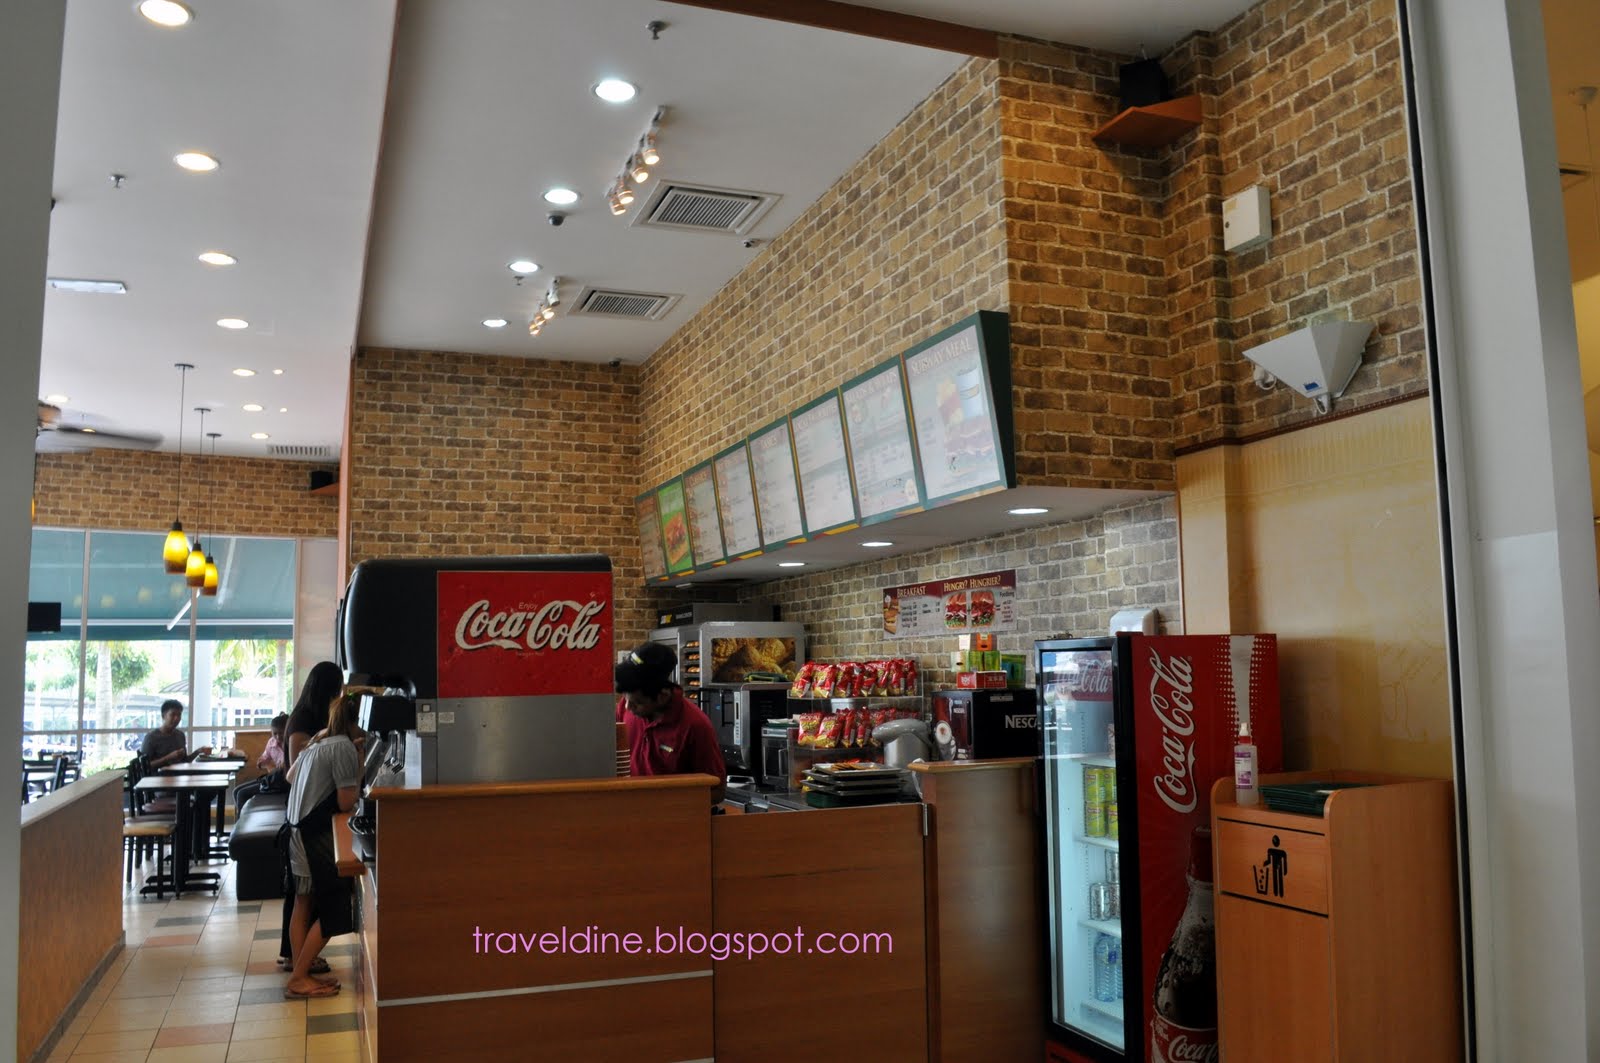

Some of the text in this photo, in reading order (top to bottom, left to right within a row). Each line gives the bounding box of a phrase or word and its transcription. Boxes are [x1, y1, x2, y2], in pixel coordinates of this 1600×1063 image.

[946, 336, 973, 361] MEAL
[897, 585, 926, 599] BREAKFAST
[943, 575, 1001, 592] HUNGRY? HUNGRIER?
[518, 601, 538, 611] Enjoy
[455, 599, 606, 650] Coca-Cola
[1149, 646, 1198, 813] Coca-Cola
